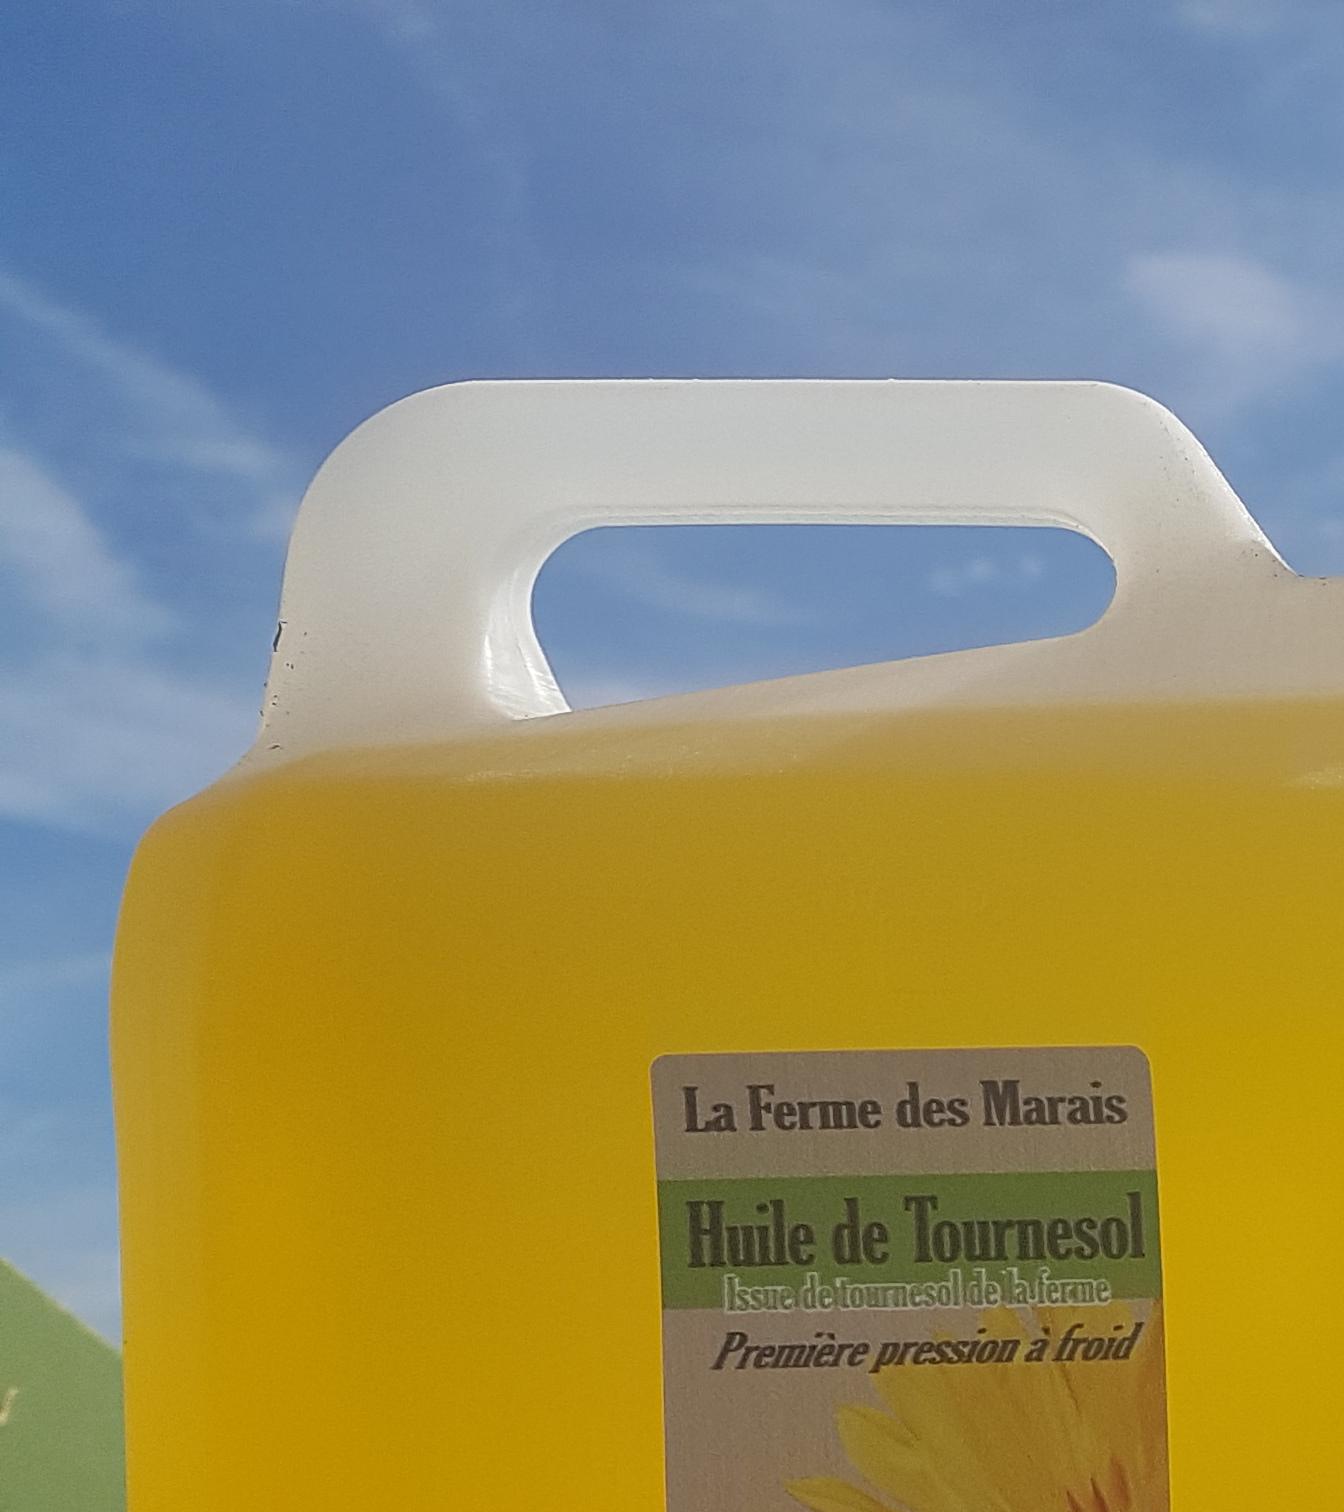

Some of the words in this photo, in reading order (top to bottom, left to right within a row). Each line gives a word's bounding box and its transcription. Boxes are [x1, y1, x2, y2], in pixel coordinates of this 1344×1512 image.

[682, 1086, 737, 1132] La
[746, 1084, 882, 1131] Ferme
[896, 1081, 970, 1128] des
[979, 1080, 1128, 1127] Marais
[686, 1199, 816, 1268] Huile
[831, 1197, 890, 1265] de
[904, 1191, 1146, 1264] Tournesol
[723, 1275, 794, 1313] Issue
[801, 1272, 833, 1311] de
[833, 1269, 963, 1311] tournesol
[968, 1268, 1000, 1307] de
[1001, 1267, 1034, 1306] la
[1031, 1266, 1110, 1306] ferme
[711, 1331, 869, 1370] Première
[868, 1328, 1020, 1373] pression
[1024, 1327, 1045, 1362] à
[1045, 1322, 1144, 1363] froid
